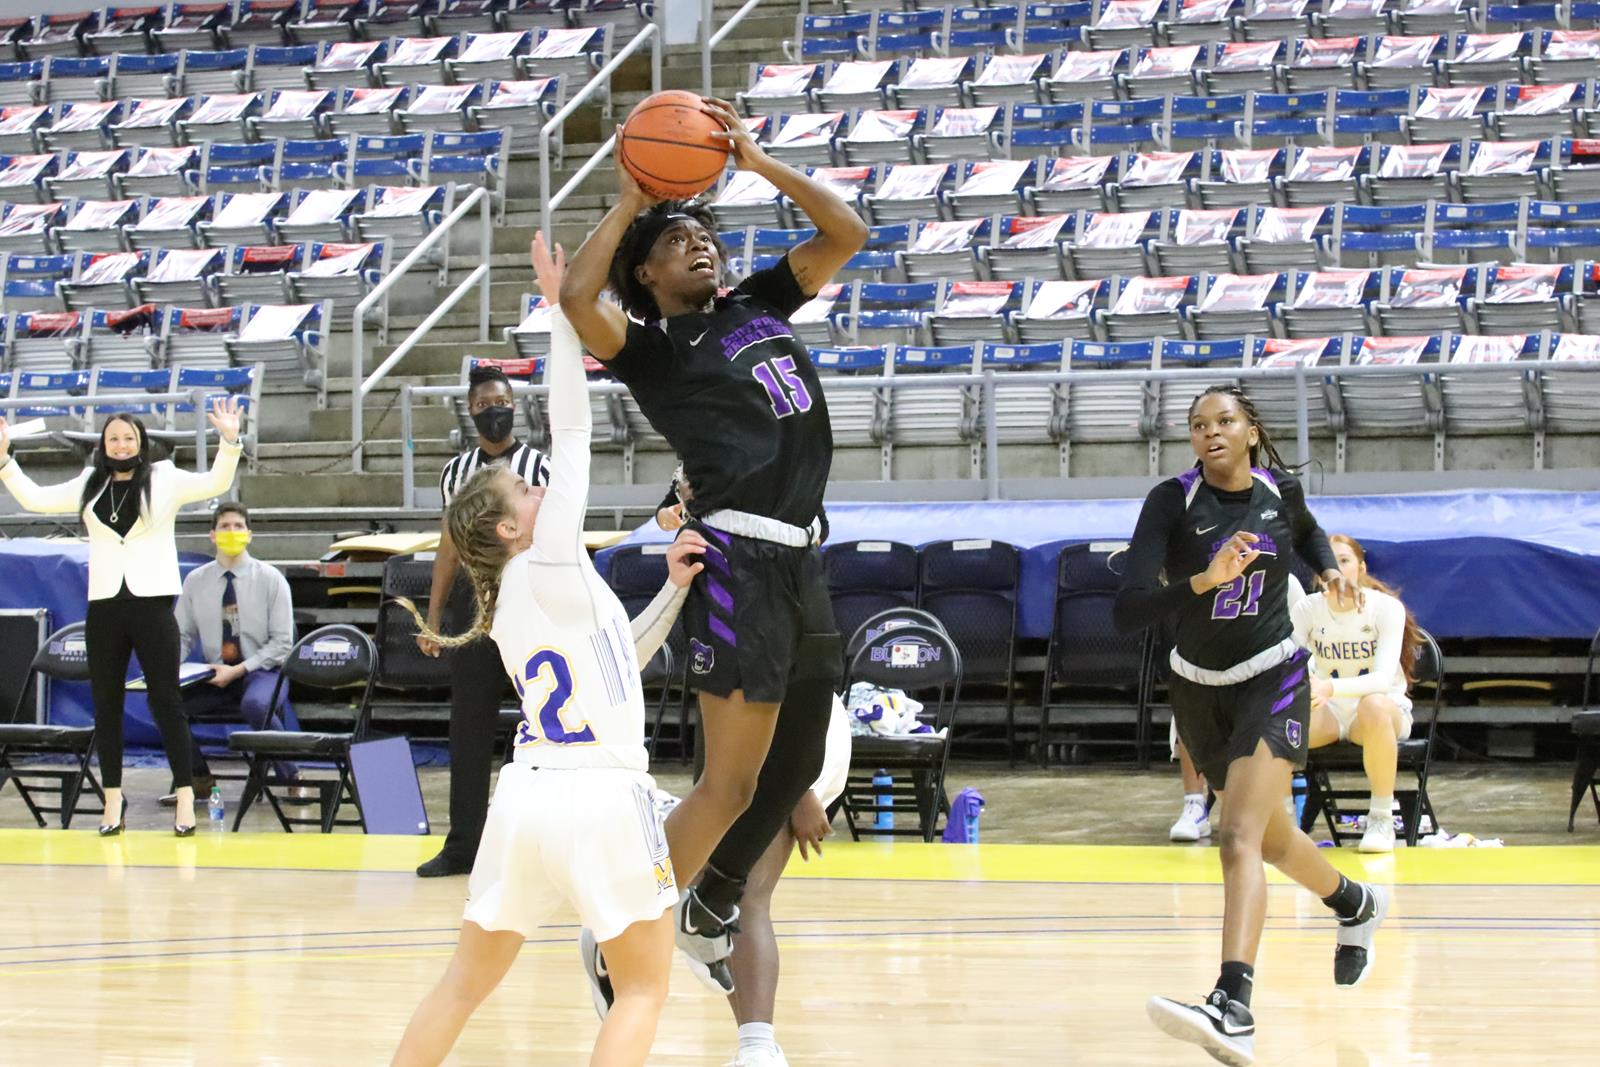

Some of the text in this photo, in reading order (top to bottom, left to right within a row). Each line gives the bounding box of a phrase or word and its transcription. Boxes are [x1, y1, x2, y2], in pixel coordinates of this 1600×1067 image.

[752, 355, 812, 419] 15
[1211, 570, 1265, 620] 21
[870, 646, 941, 662] BUON
